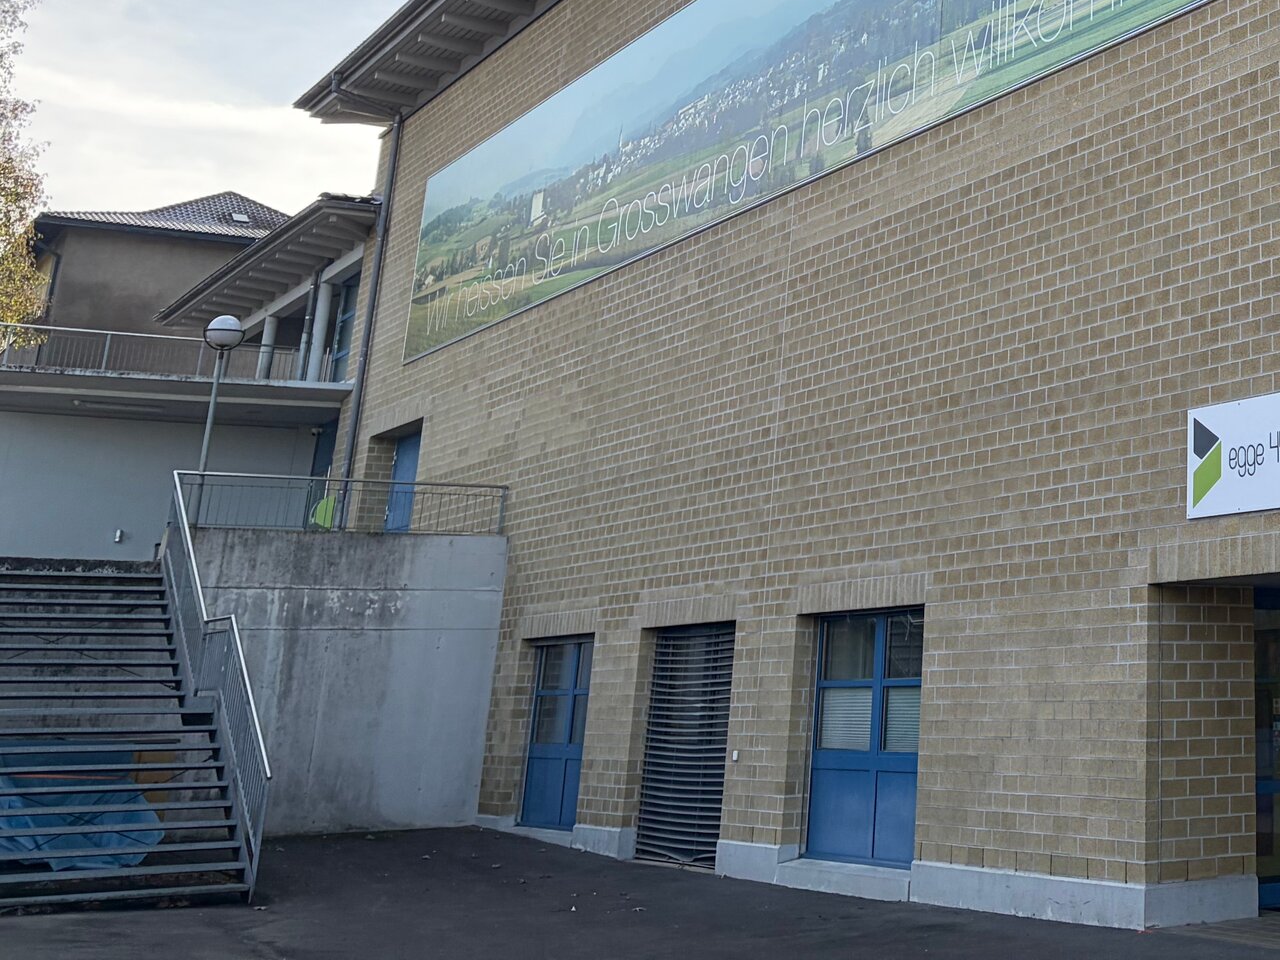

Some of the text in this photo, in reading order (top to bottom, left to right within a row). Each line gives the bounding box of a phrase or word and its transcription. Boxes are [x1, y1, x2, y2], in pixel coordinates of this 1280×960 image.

[426, 286, 453, 335] Wir
[455, 255, 527, 322] heissen
[532, 230, 566, 286] Sie
[571, 217, 590, 268] in
[597, 123, 788, 254] Grosswangen
[800, 40, 936, 158] herzlich
[1228, 443, 1265, 478] egge
